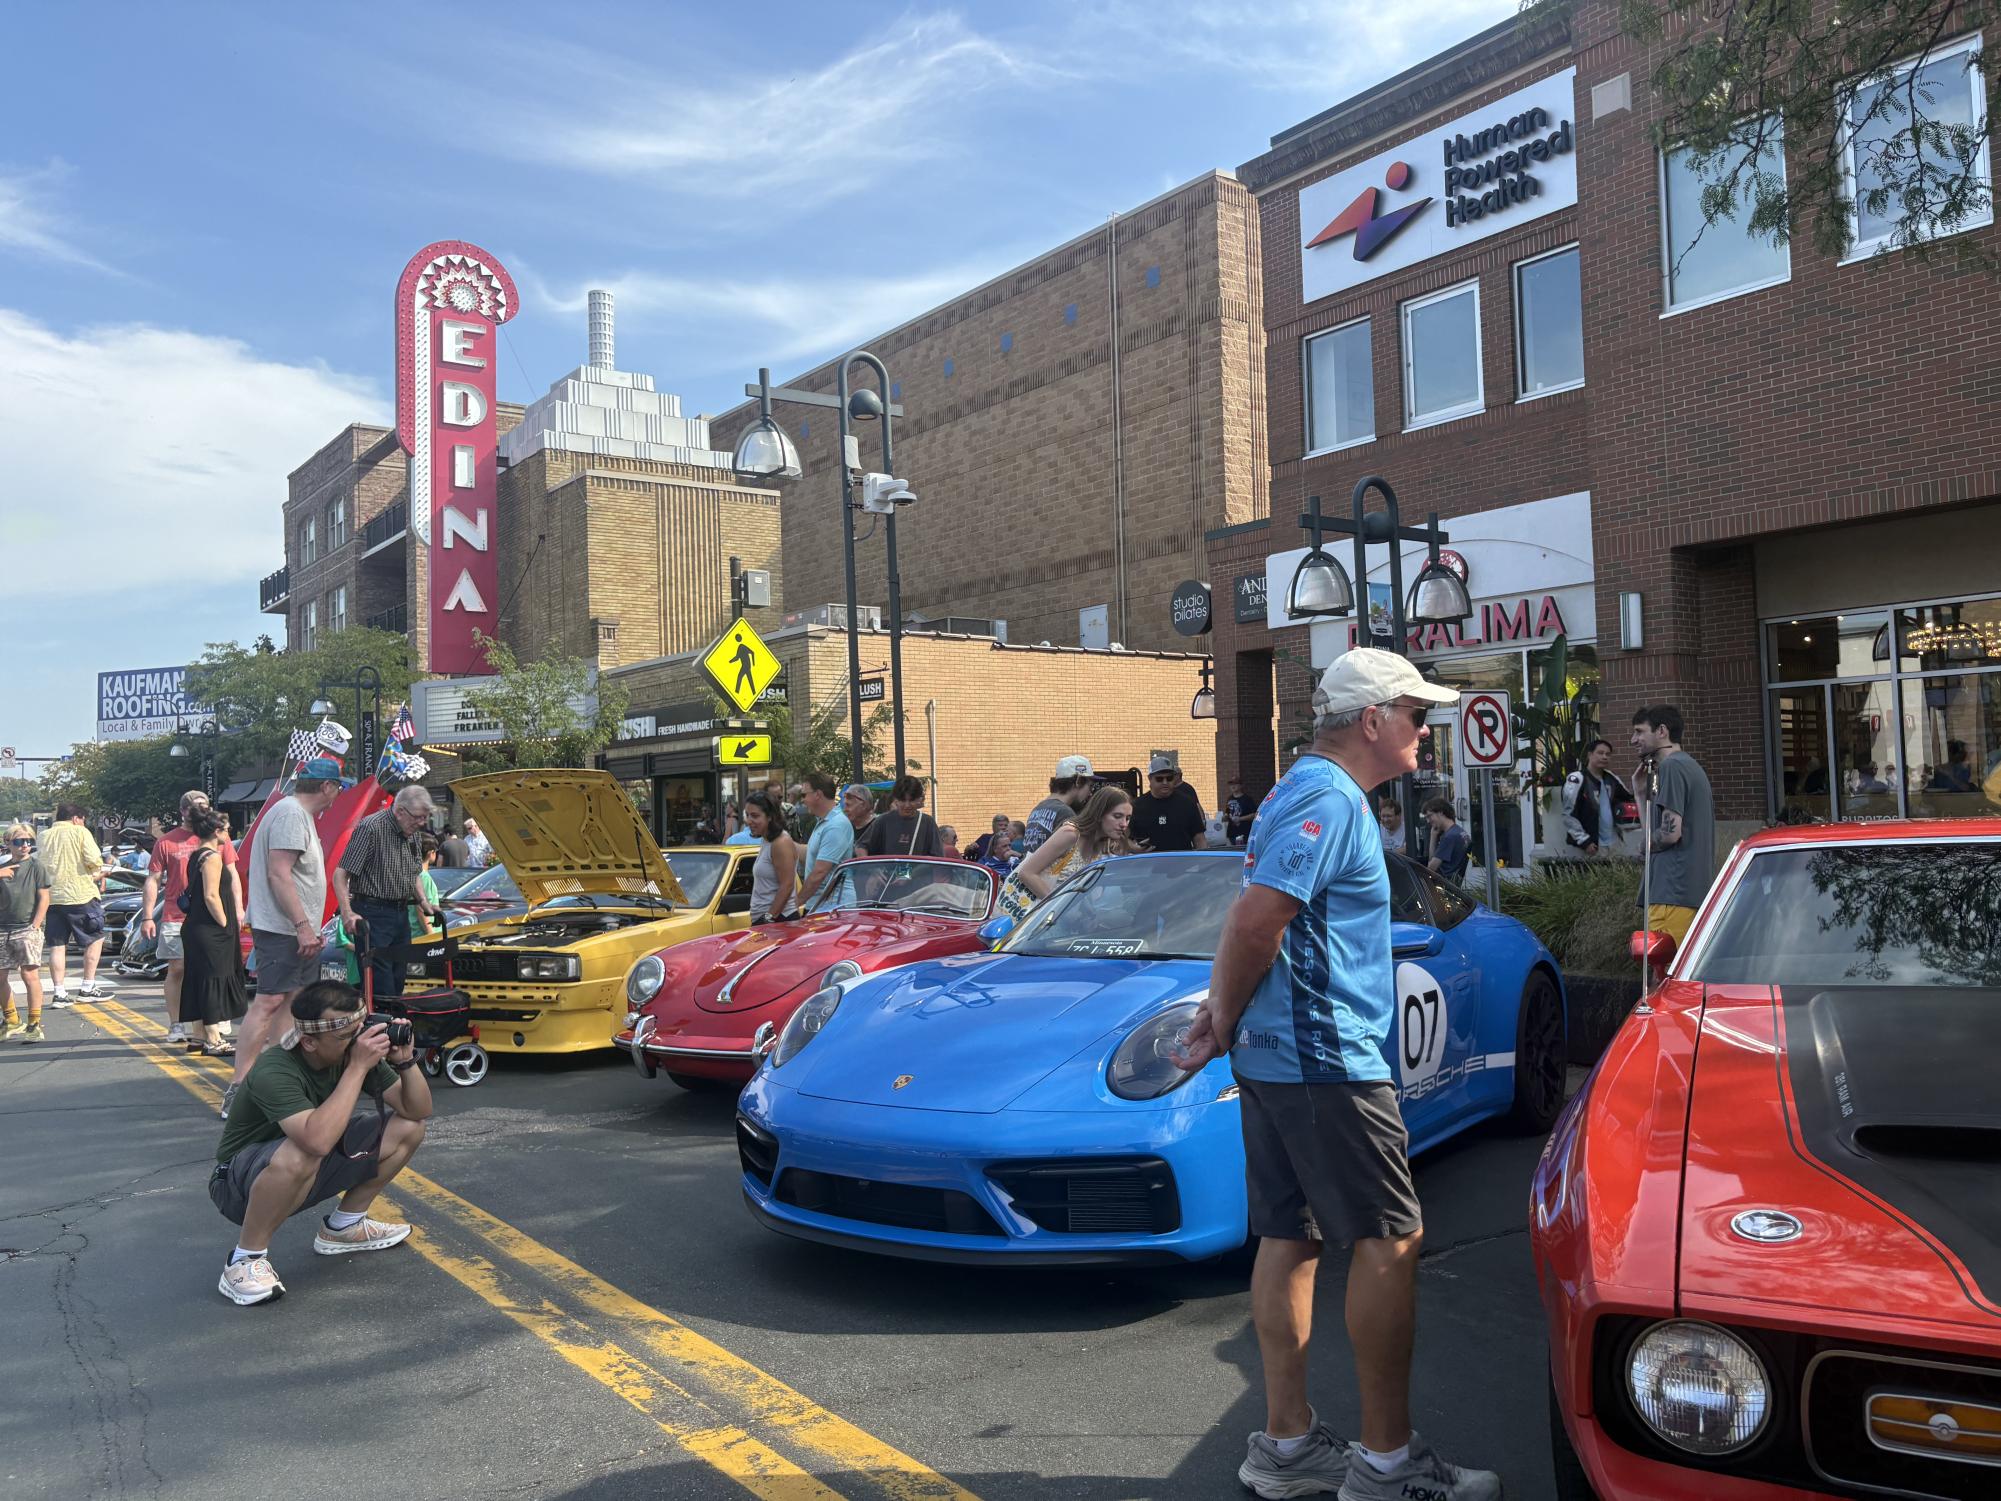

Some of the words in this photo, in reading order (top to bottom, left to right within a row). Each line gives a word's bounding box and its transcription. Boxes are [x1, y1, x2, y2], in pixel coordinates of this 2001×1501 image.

[1443, 107, 1547, 167] Human
[1444, 120, 1570, 197] Powered
[1446, 170, 1538, 228] Health
[441, 319, 488, 613] EDINA
[1173, 594, 1204, 609] studio
[1174, 607, 1207, 624] pilates
[102, 671, 186, 697] KAUFMAN
[860, 682, 882, 696] LUSH
[103, 721, 128, 733] Local
[131, 720, 139, 731] &
[141, 718, 174, 731] Family
[658, 725, 676, 736] FRESH
[677, 720, 710, 733] HANDMADE
[1301, 819, 1322, 835] ICA
[426, 947, 445, 957] drive
[1404, 990, 1439, 1070] 07
[1401, 1484, 1446, 1500] HOKA
